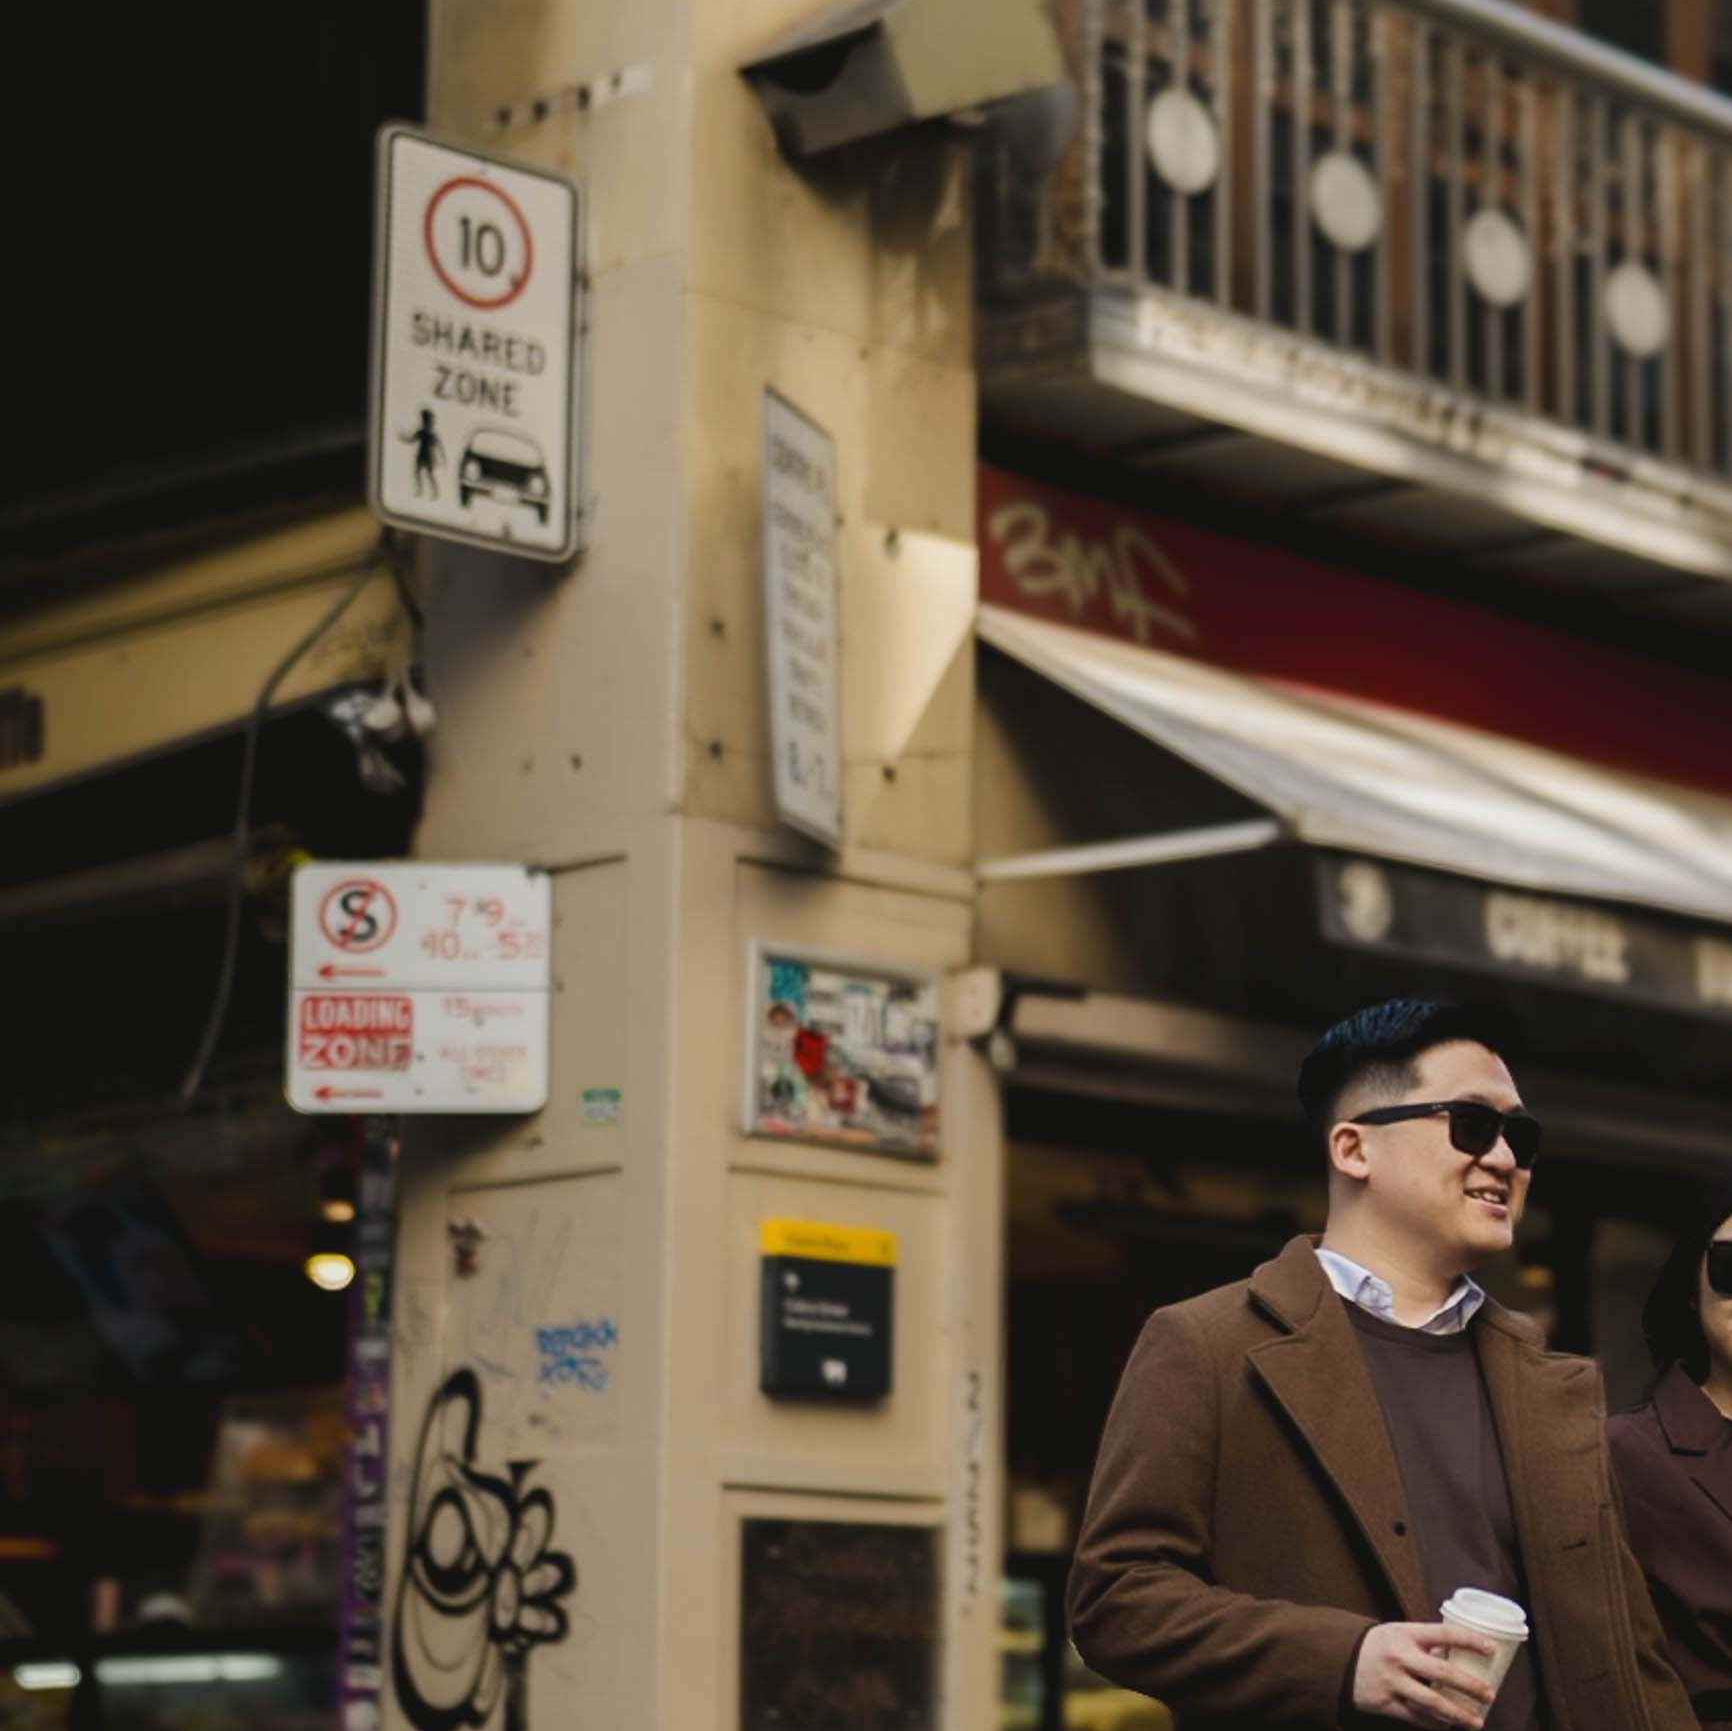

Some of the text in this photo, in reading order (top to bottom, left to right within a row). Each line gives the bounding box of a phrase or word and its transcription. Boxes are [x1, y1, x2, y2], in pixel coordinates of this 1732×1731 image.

[458, 213, 505, 277] 10
[411, 313, 547, 376] SHARED
[433, 366, 522, 418] ZONE
[303, 998, 411, 1030] LOADING
[301, 1035, 410, 1068] ZONE
